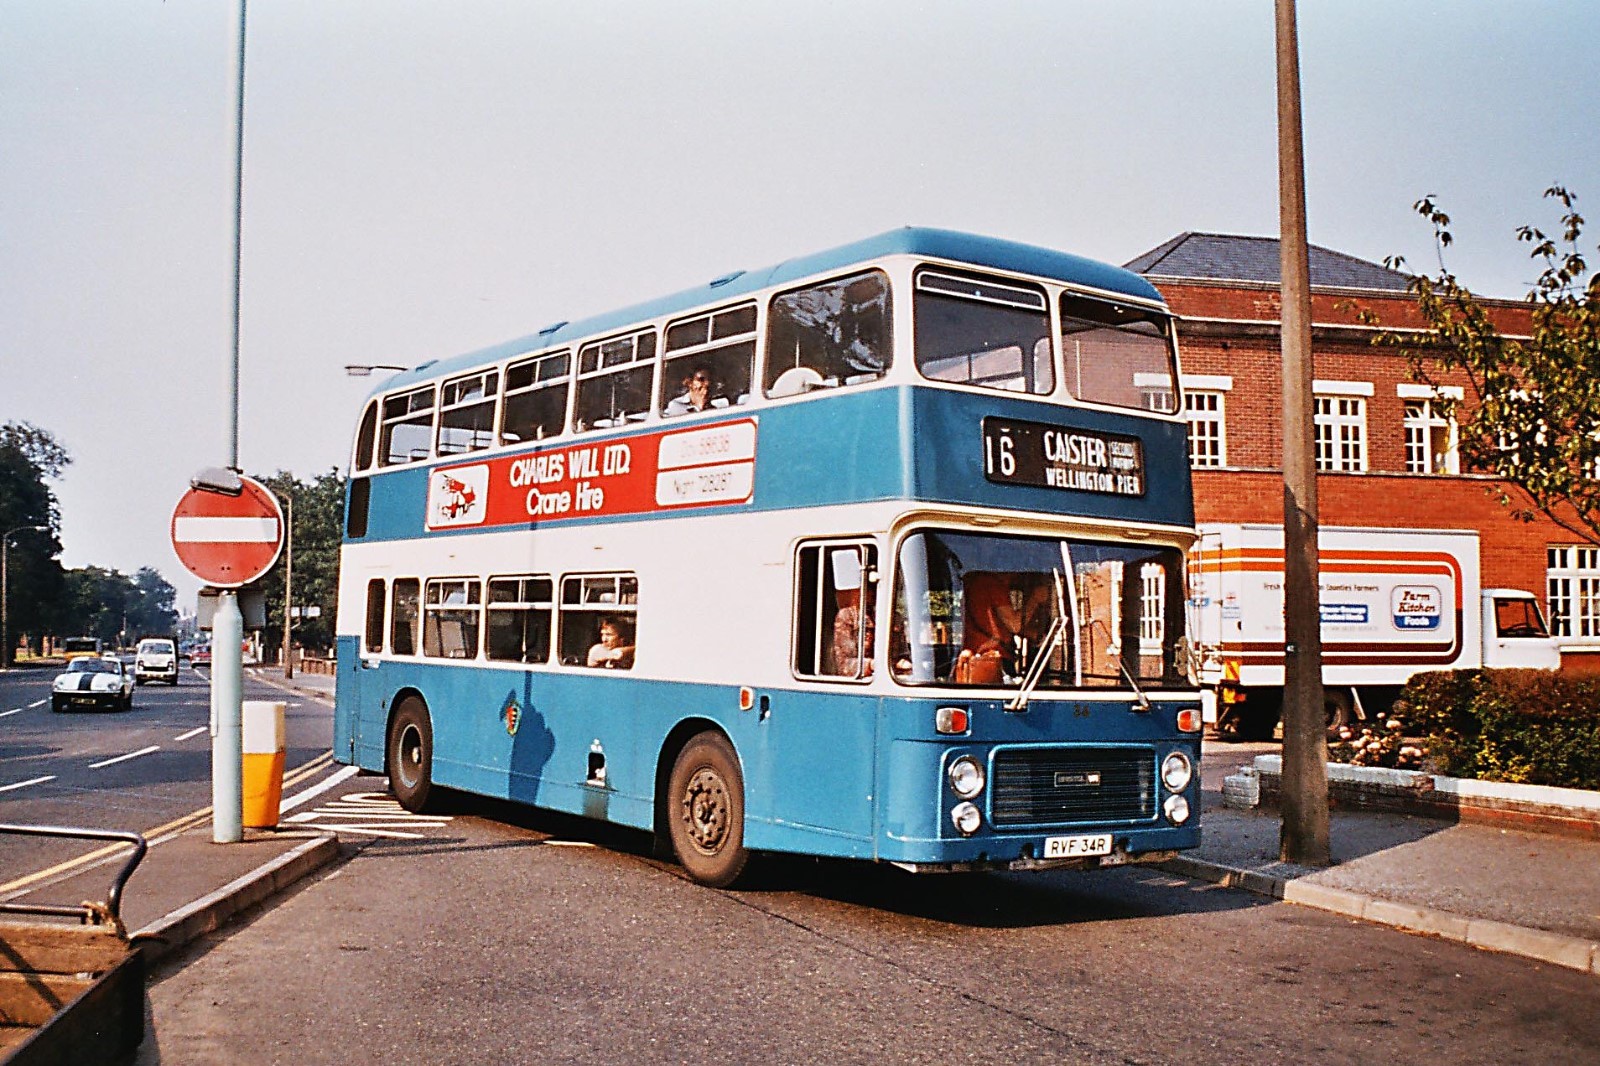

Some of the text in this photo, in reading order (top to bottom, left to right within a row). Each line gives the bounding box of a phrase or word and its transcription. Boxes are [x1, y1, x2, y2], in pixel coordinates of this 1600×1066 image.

[985, 435, 1016, 476] 16
[1043, 431, 1107, 468] CAISTER
[509, 453, 565, 488] CHARLES
[568, 447, 600, 479] WILL
[1045, 467, 1140, 495] WELLINGTON PIER
[526, 481, 604, 516] Crane Hire
[1354, 584, 1380, 592] Farmers
[1402, 590, 1430, 601] Farm
[1398, 602, 1436, 613] Kitchen
[1051, 838, 1106, 854] RVF 34R
